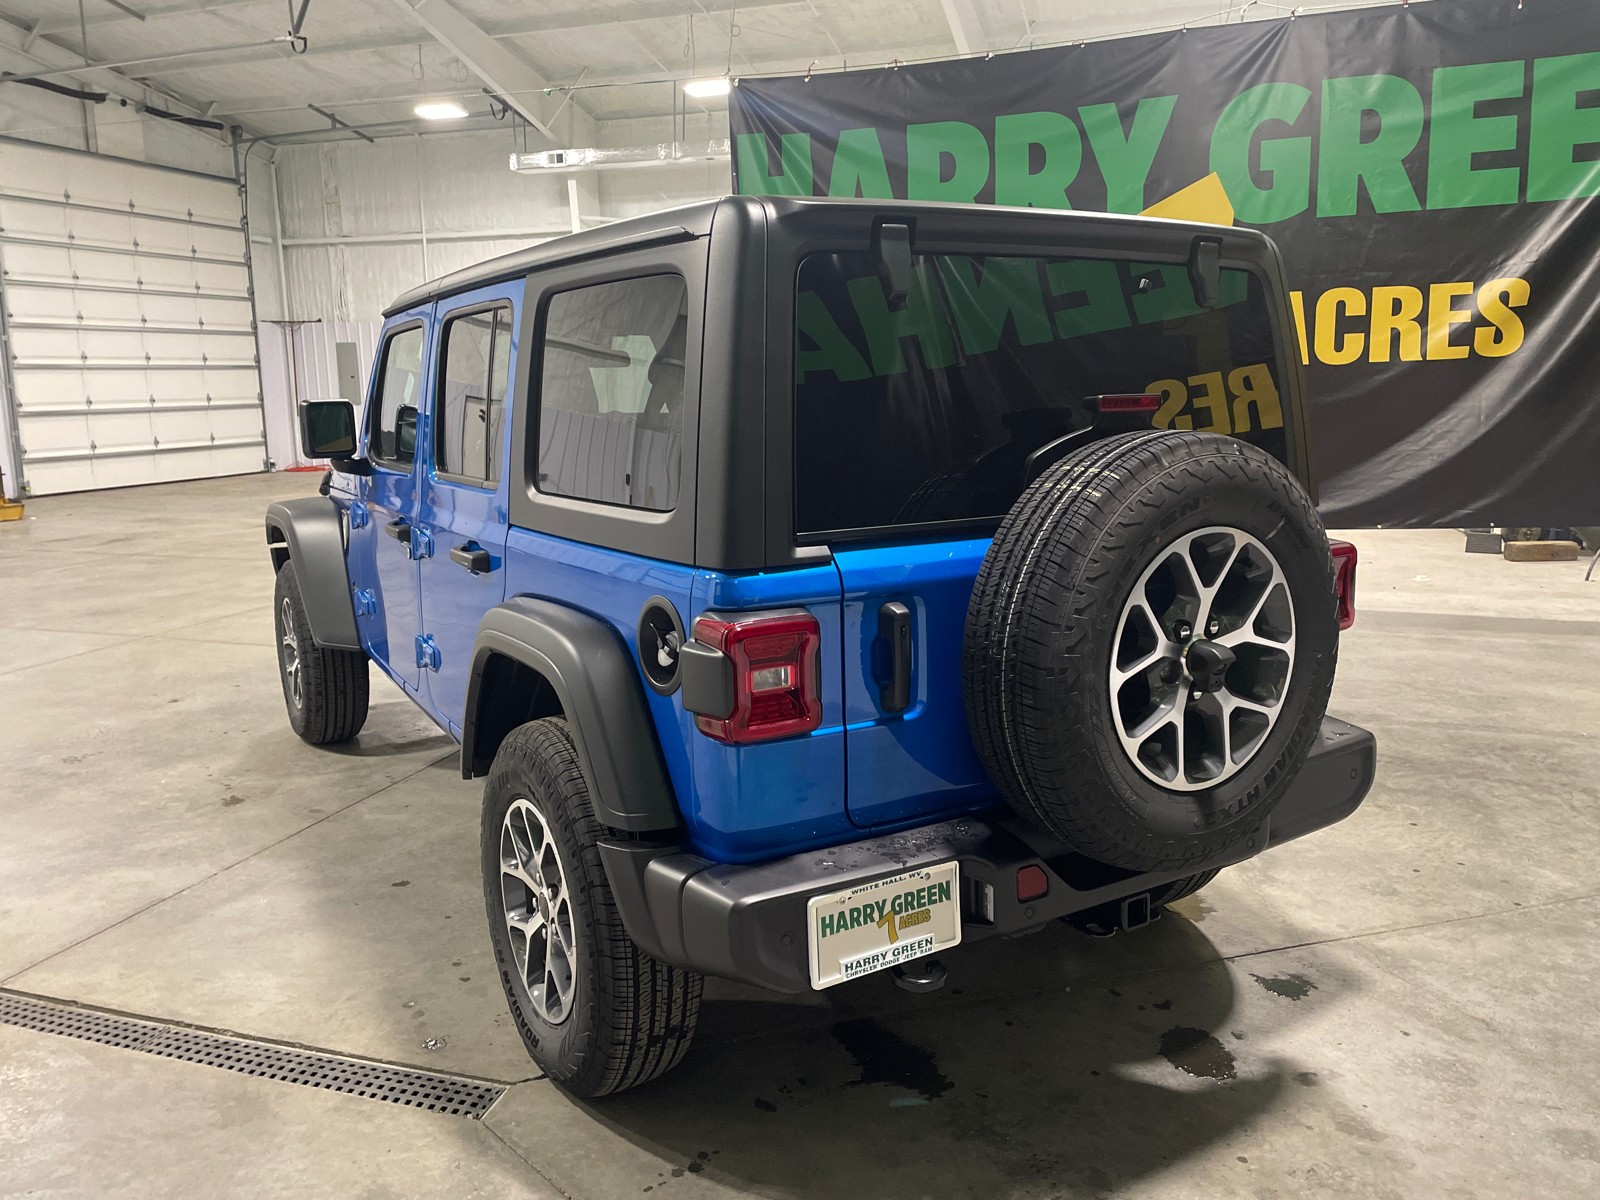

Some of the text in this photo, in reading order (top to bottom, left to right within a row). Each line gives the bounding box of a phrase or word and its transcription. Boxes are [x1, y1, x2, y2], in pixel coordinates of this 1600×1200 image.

[737, 95, 1179, 214] HARRY
[851, 882, 880, 895] WHITE
[909, 871, 922, 879] WV
[820, 880, 952, 938] HARRY GREEN
[898, 908, 931, 931] ACRES
[877, 910, 899, 945] 7
[844, 937, 933, 973] HARRY GREEN
[845, 964, 878, 979] CHRYSLER
[880, 957, 900, 968] DODGE
[903, 952, 917, 961] JEEP
